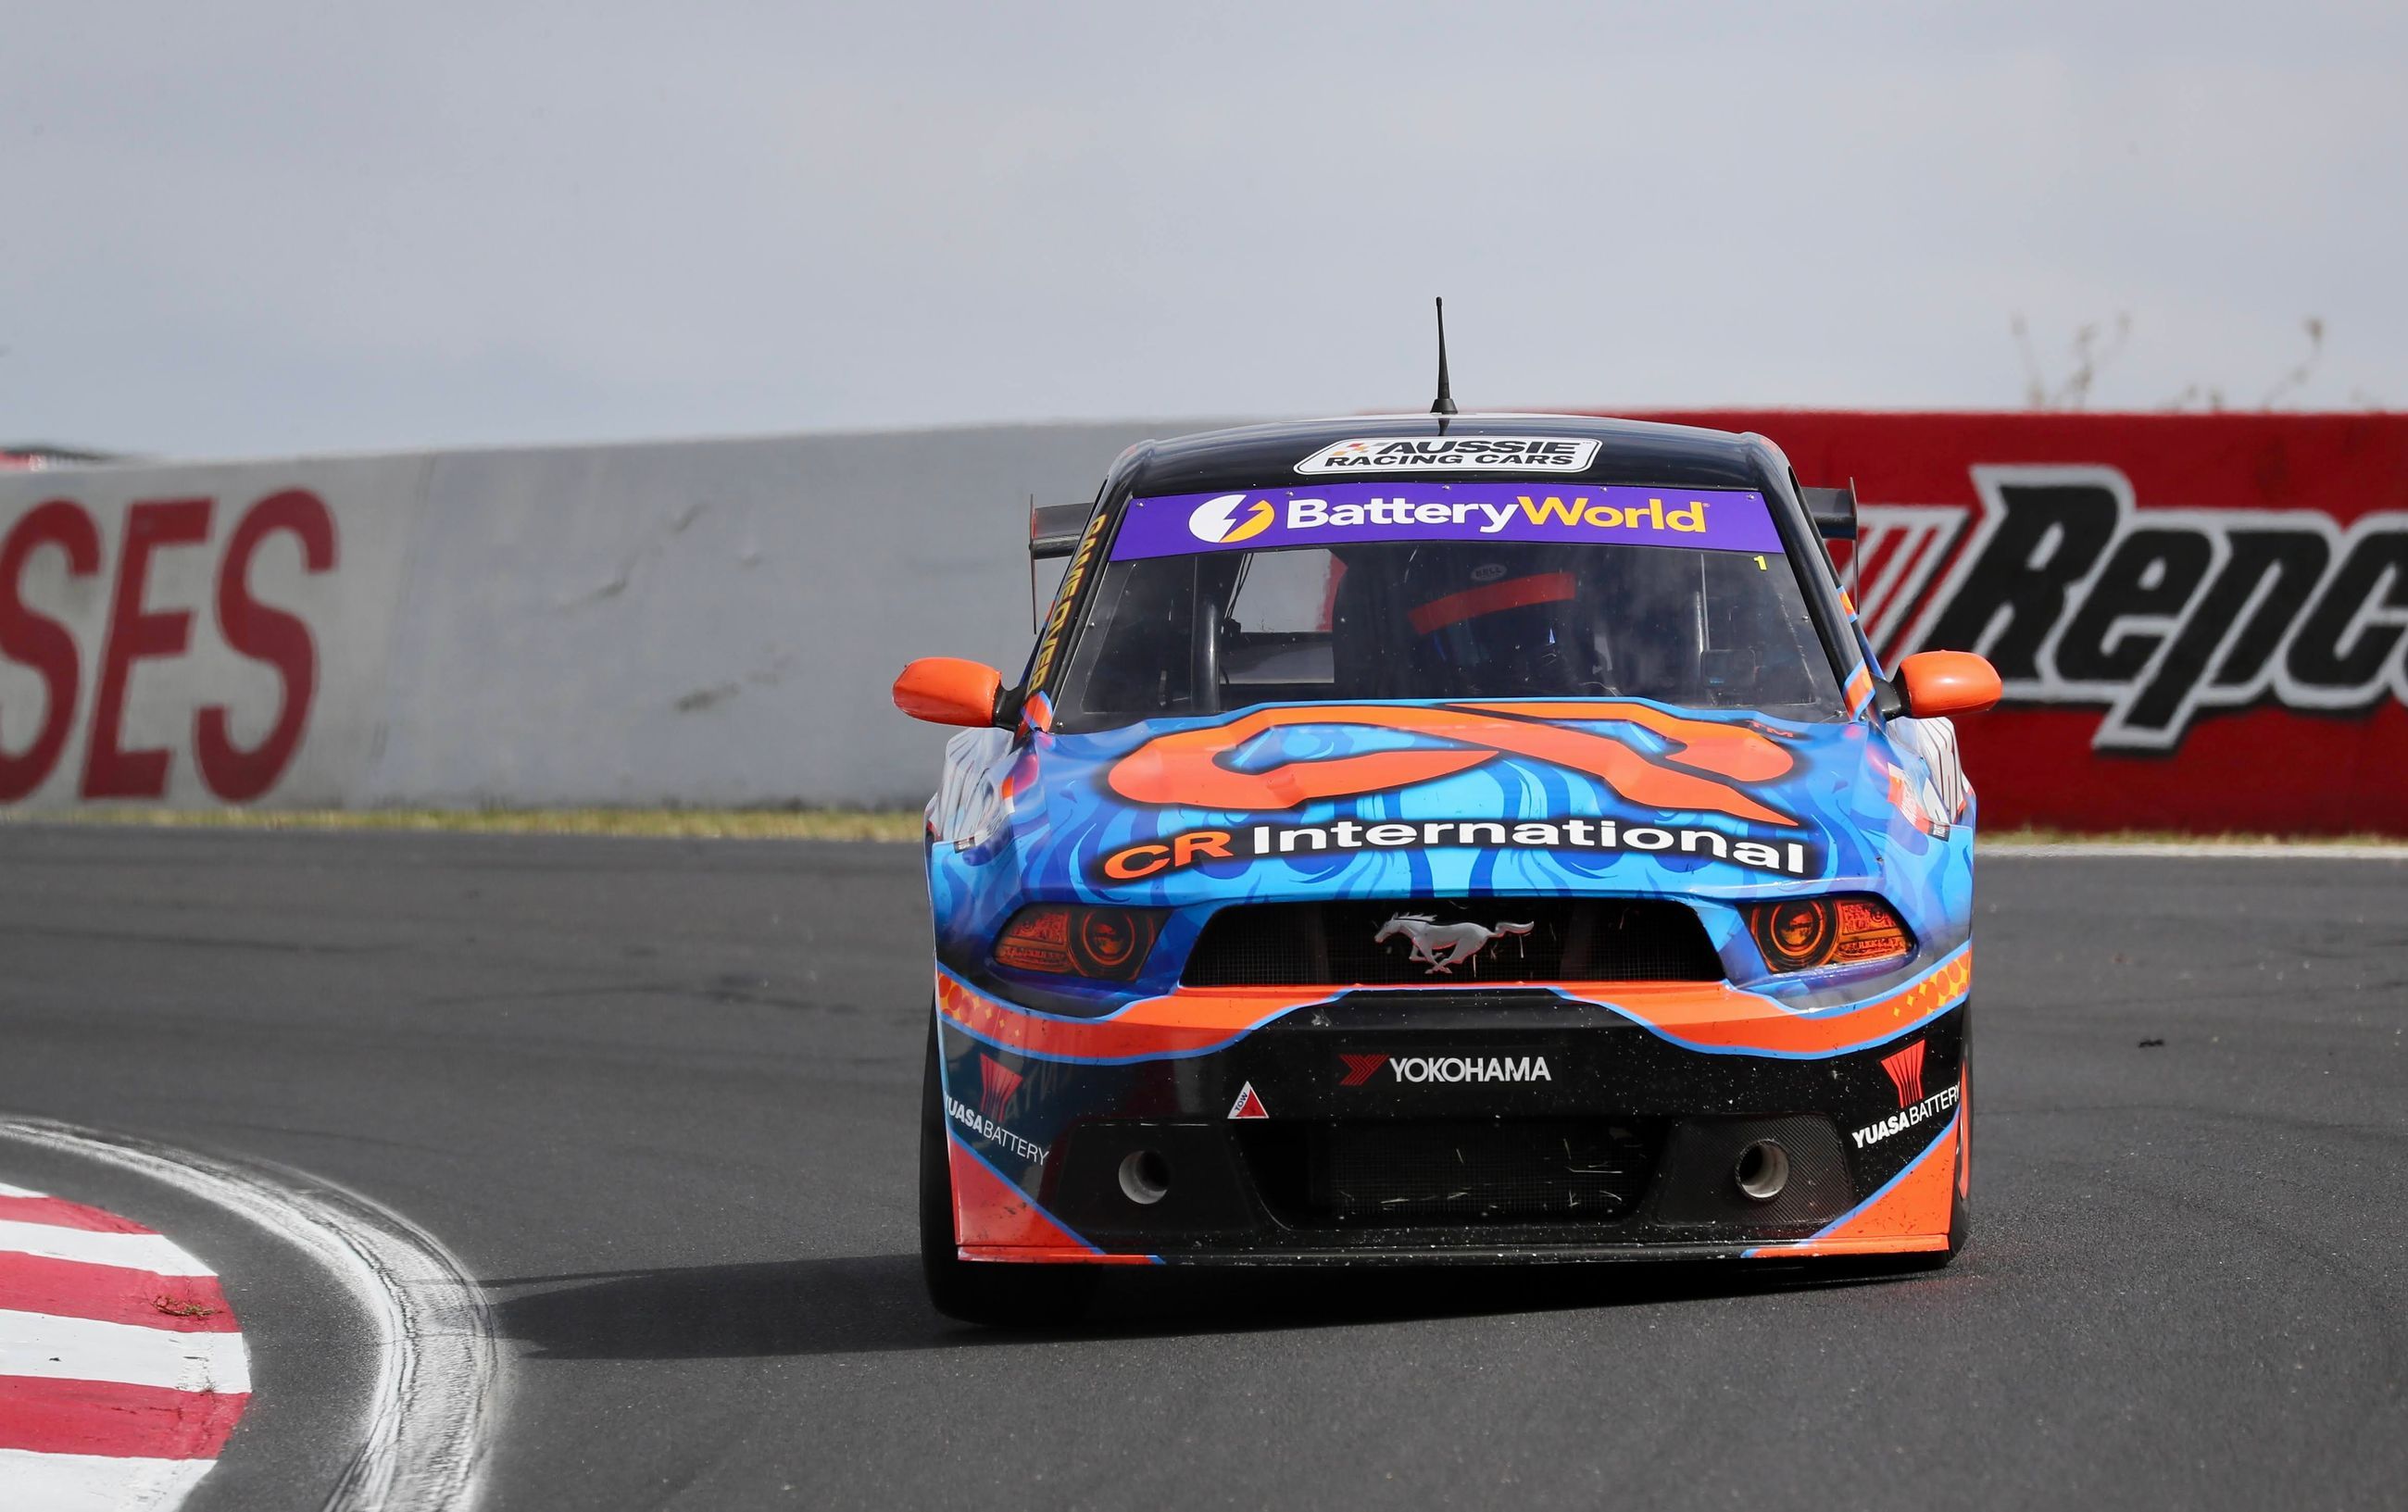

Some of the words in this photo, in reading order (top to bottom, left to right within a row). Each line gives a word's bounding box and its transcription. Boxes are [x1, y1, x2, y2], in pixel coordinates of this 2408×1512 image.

[1374, 440, 1580, 455] AUSSIE
[1323, 454, 1464, 468] RACING
[1474, 454, 1574, 466] CARS
[1753, 556, 1768, 571] 1
[1903, 466, 2408, 748] Repc
[0, 486, 340, 804] SES
[1104, 830, 1235, 880] CR
[1253, 819, 1804, 873] International
[1389, 1056, 1552, 1083] YOKOHAMA
[1234, 1092, 1248, 1112] TOW
